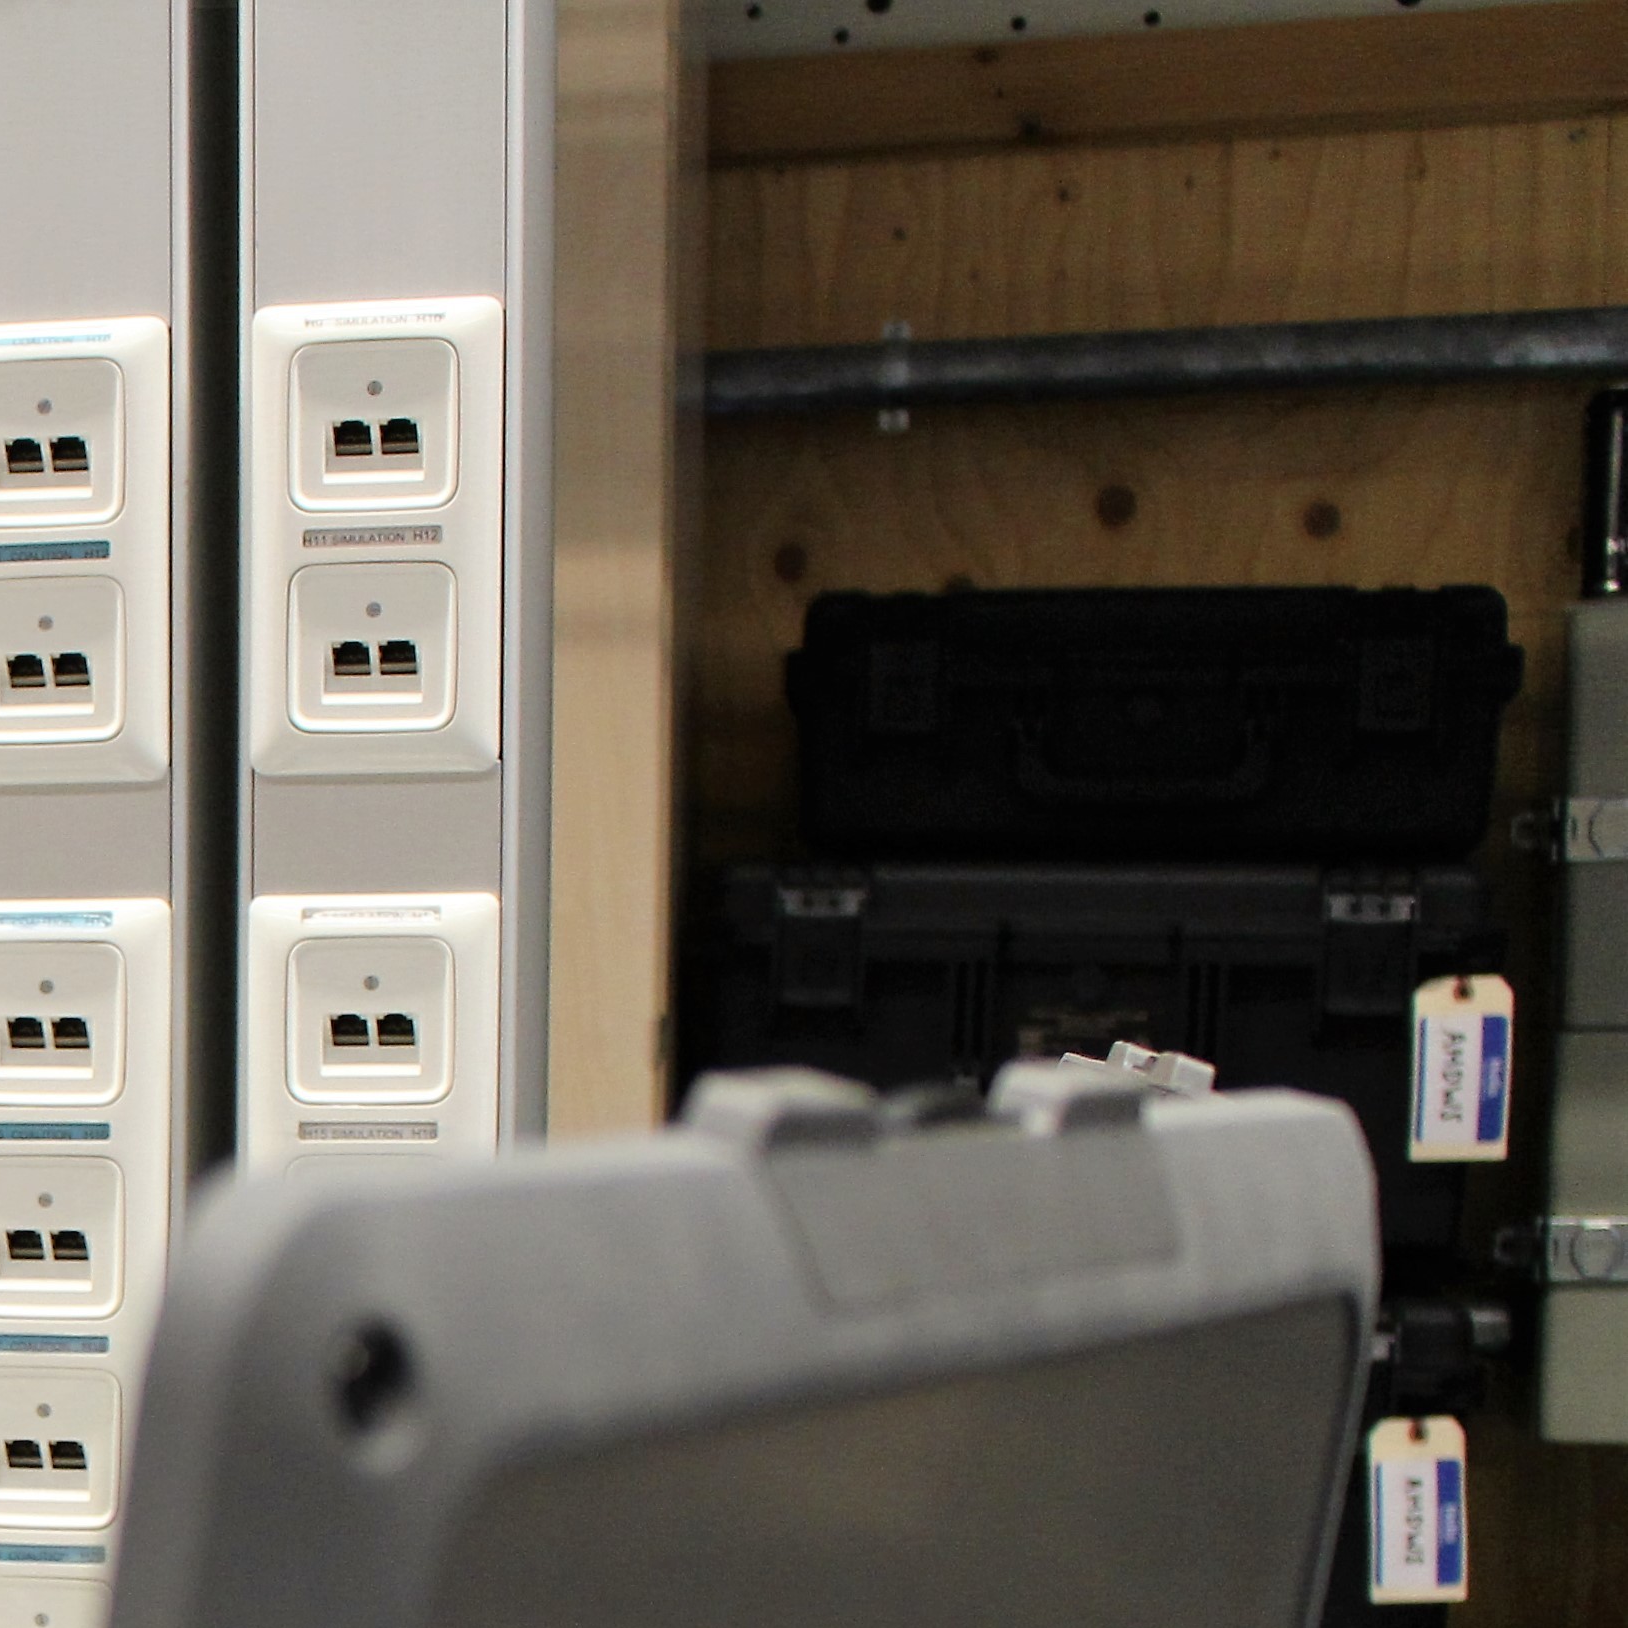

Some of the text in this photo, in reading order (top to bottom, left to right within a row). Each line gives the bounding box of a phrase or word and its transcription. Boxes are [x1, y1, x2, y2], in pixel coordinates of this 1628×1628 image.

[335, 315, 407, 327] SIMULATION
[332, 532, 405, 546] SIMULATION
[331, 1127, 404, 1141] SIMULATION
